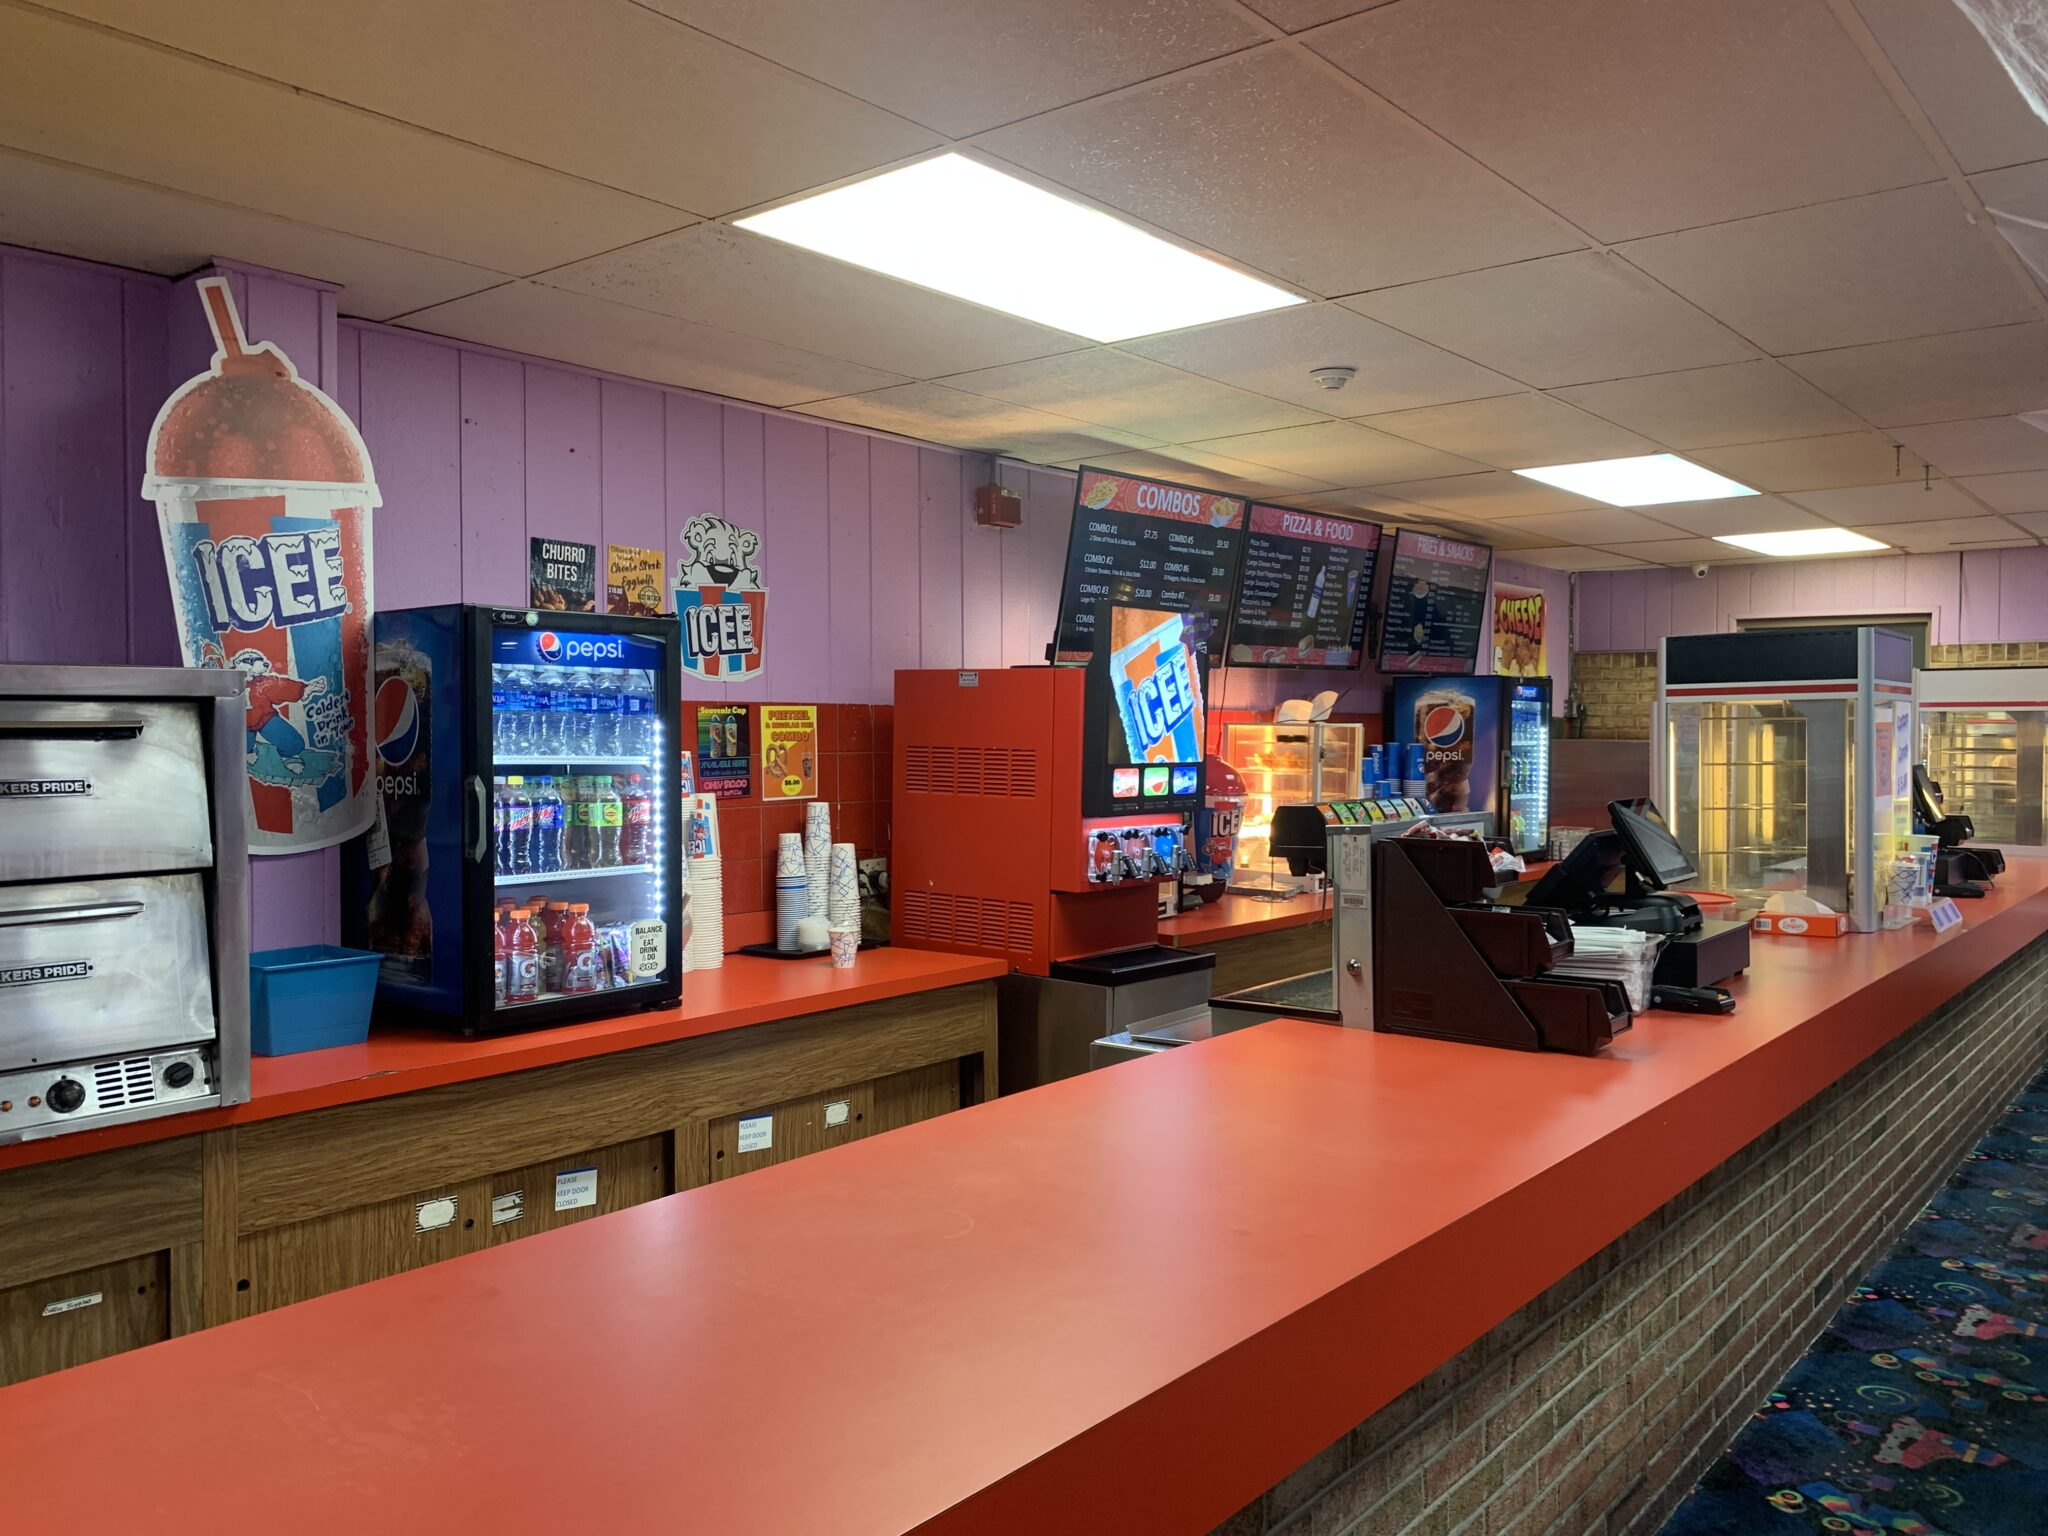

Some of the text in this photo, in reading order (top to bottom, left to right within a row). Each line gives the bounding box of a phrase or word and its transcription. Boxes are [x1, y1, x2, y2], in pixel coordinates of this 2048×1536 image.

[1137, 485, 1201, 517] COMBOS
[1089, 522, 1110, 533] COMBO
[1282, 513, 1353, 541] PIZZA & FOOD
[1168, 533, 1187, 544] COMBO
[542, 543, 586, 563] CHURRO
[1418, 537, 1437, 555] FRIES
[1447, 543, 1474, 561] SNACKS
[1084, 553, 1105, 564] COMBO
[547, 563, 578, 581] BITES
[1164, 562, 1182, 572] COMBO
[194, 530, 348, 633] ICEE
[1080, 584, 1101, 594] COMBO
[1161, 590, 1178, 599] Combo
[1499, 594, 1542, 645] CHEESE
[685, 604, 754, 657] ICEE
[566, 639, 624, 662] pepsi
[306, 690, 351, 719] Coldest
[1128, 650, 1195, 752] ICEE
[700, 706, 747, 715] Souvenir Cup
[768, 710, 810, 720] PRETZEL
[317, 710, 348, 731] Drink
[771, 731, 809, 742] COMBO
[1426, 749, 1462, 763] pepsi
[0, 781, 84, 794] KERS PRIDE
[376, 771, 417, 800] pepsi
[636, 925, 663, 934] BALANCE
[640, 946, 658, 954] DRINK
[1, 963, 87, 982] KERS PRIDE
[741, 1122, 757, 1130] PLEASE
[740, 1131, 767, 1141] KEEP DOOR
[740, 1143, 758, 1151] CLOSED
[557, 1176, 577, 1185] PLEASE
[557, 1186, 589, 1197] KEEP DOOR
[556, 1198, 578, 1208] CLOSED
